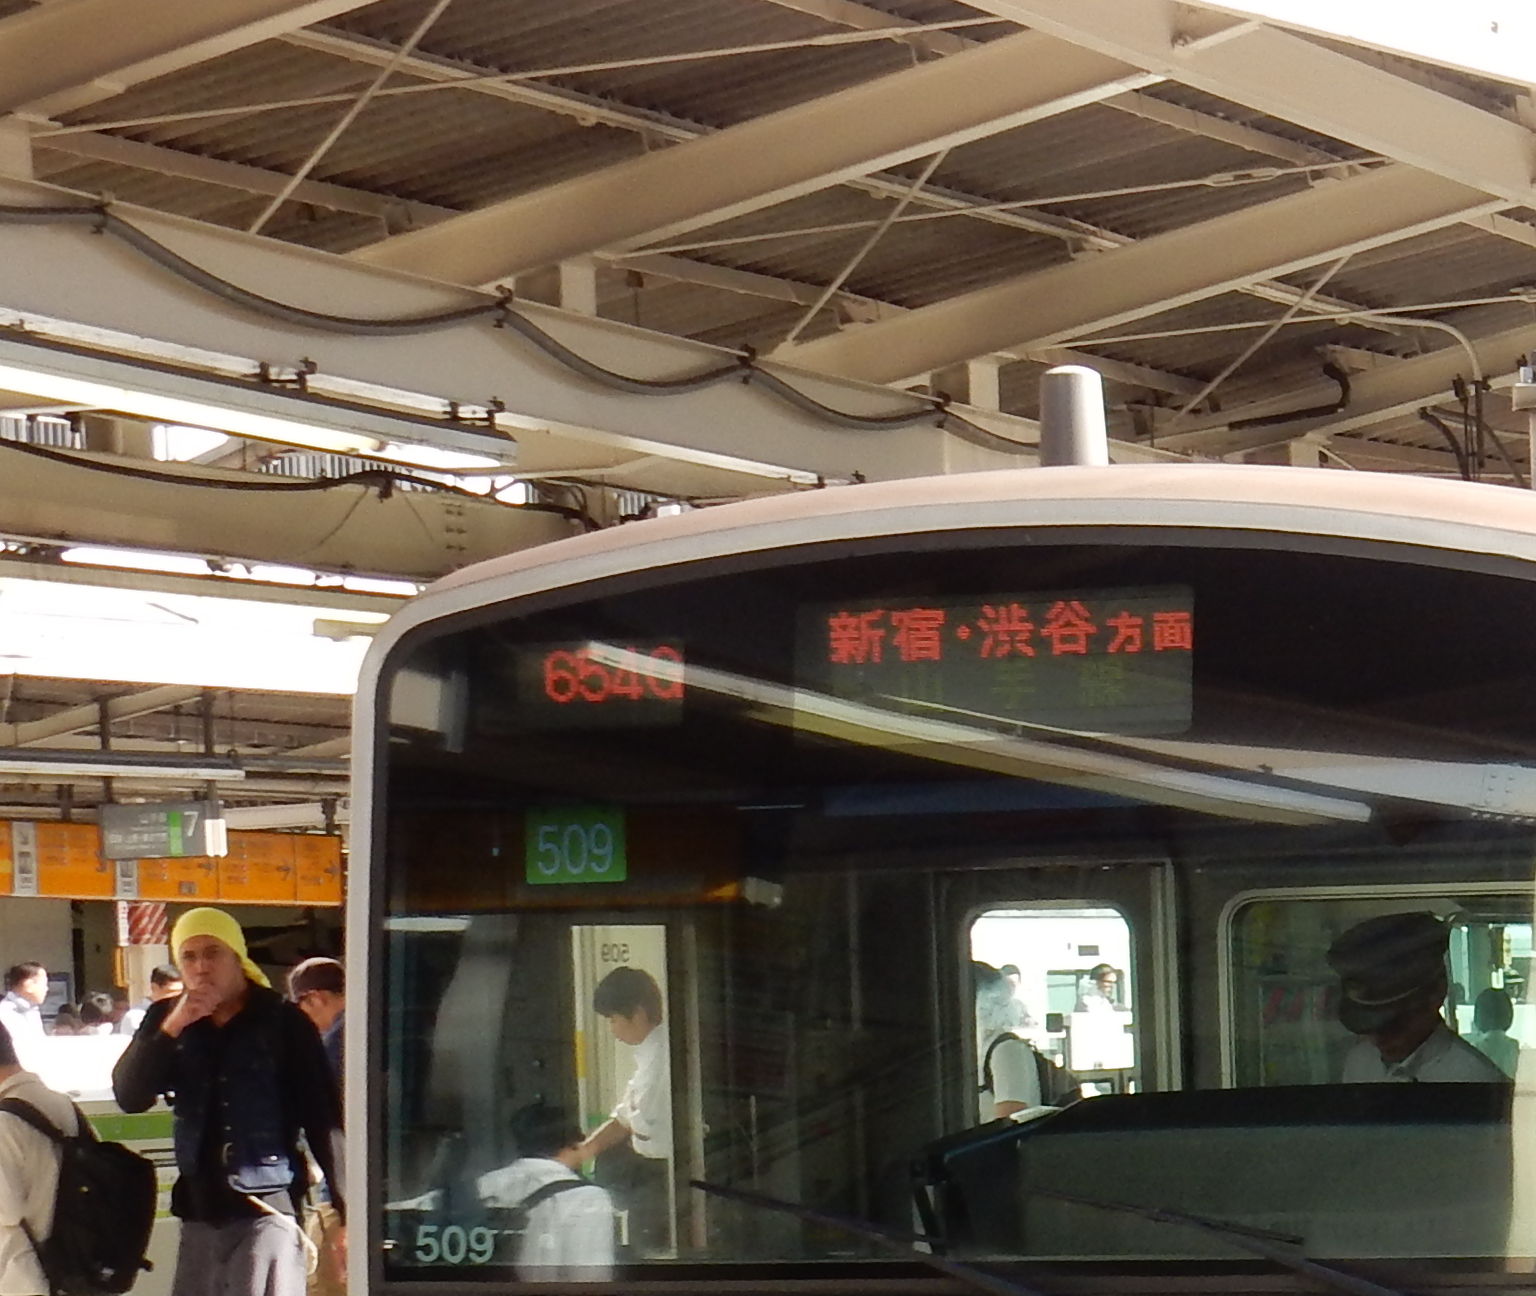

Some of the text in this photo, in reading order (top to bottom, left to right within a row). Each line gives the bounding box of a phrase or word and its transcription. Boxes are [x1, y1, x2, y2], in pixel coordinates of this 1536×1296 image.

[829, 600, 1194, 664] 新宿・渋谷方面
[184, 811, 199, 837] 7
[537, 822, 614, 876] 509
[416, 1224, 495, 1264] 509
